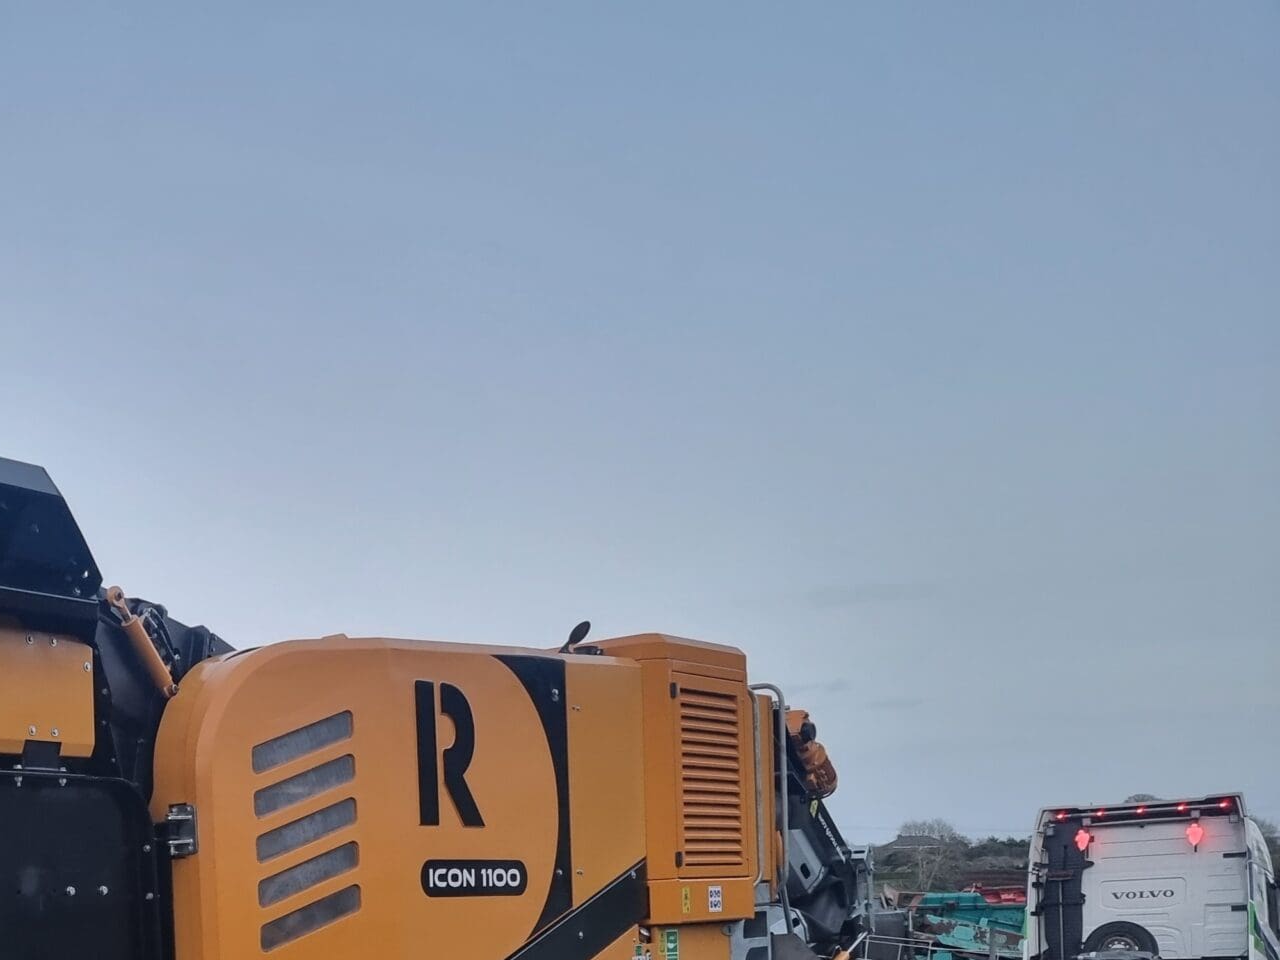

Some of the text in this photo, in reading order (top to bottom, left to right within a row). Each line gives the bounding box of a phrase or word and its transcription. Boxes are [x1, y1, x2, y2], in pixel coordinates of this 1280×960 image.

[415, 680, 485, 827] R
[428, 867, 521, 888] ICON 1100
[1111, 889, 1175, 900] VOLVO
